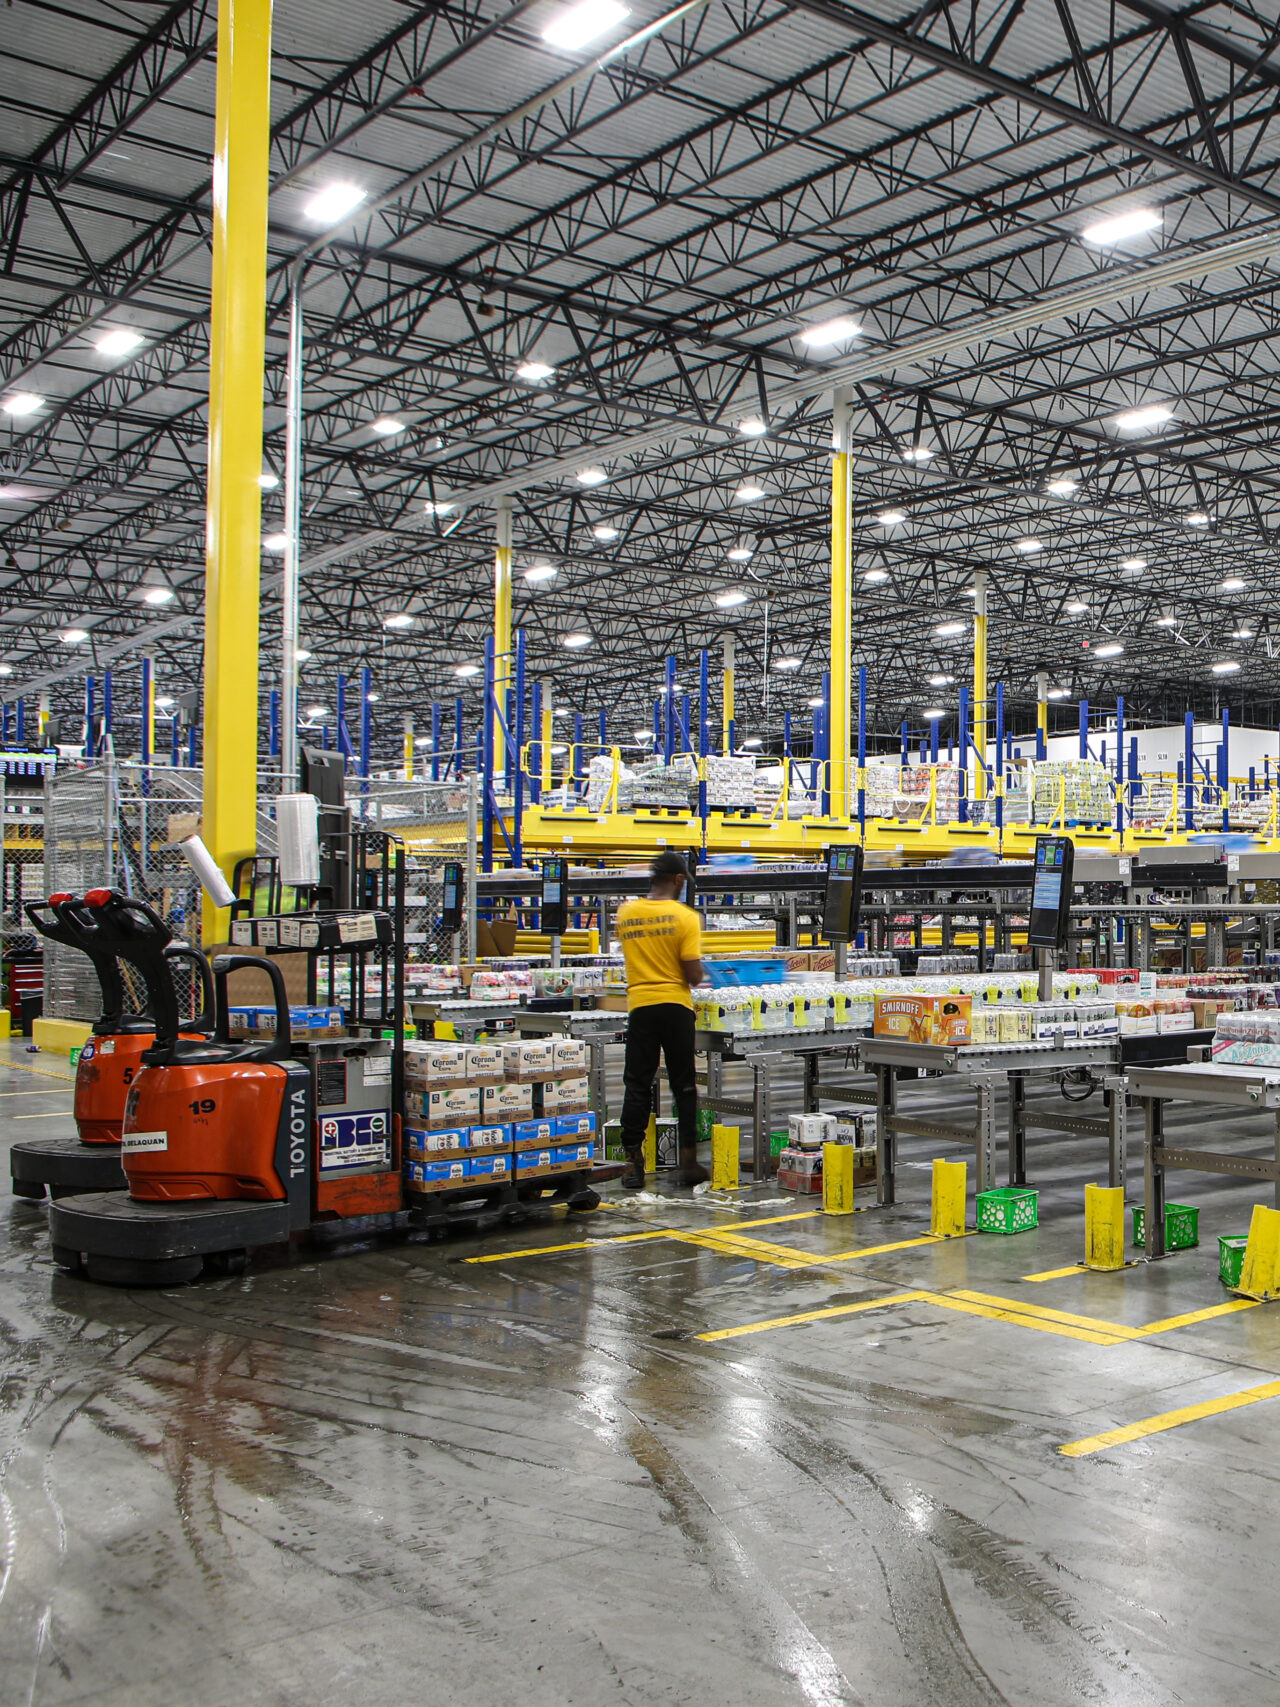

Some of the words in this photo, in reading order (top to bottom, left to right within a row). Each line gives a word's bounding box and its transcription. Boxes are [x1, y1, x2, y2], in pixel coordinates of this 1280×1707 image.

[648, 915, 675, 924] SAFE
[648, 928, 675, 936] SAFE
[882, 1002, 920, 1014] SMIRNOFF
[888, 1018, 900, 1030] ICE
[955, 1027, 966, 1035] ICE
[1232, 1046, 1270, 1062] AriZona
[432, 1059, 457, 1067] Corona
[471, 1056, 496, 1064] Corona
[123, 1068, 133, 1084] 5
[188, 1099, 215, 1115] 19
[290, 1089, 306, 1178] TOYOTA
[127, 1138, 165, 1147] DELAQUAN
